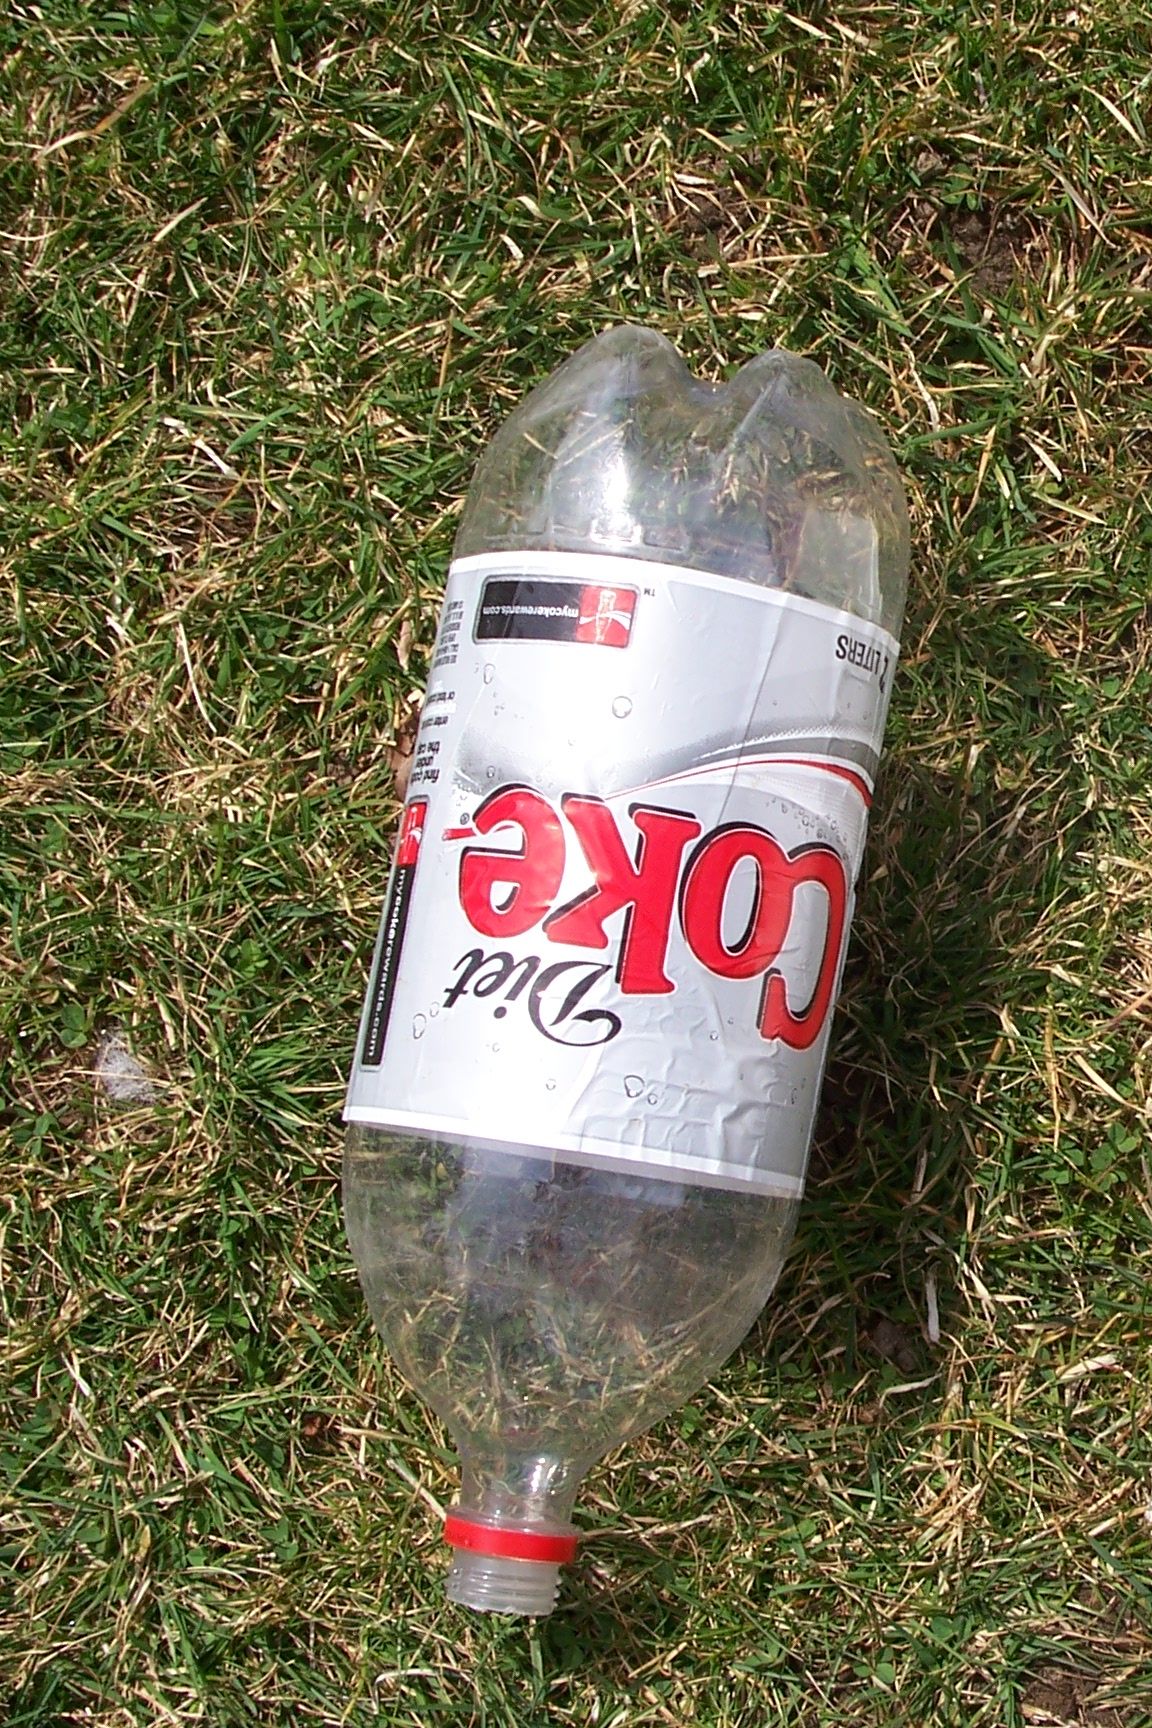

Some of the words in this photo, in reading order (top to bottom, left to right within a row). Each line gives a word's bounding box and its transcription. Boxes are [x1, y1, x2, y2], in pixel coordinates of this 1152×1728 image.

[481, 605, 580, 620] mycokerewards.com
[834, 633, 884, 671] LITERS
[366, 869, 408, 1057] mycokerewards.com
[458, 782, 847, 1052] Coke
[443, 948, 622, 1047] Diet
